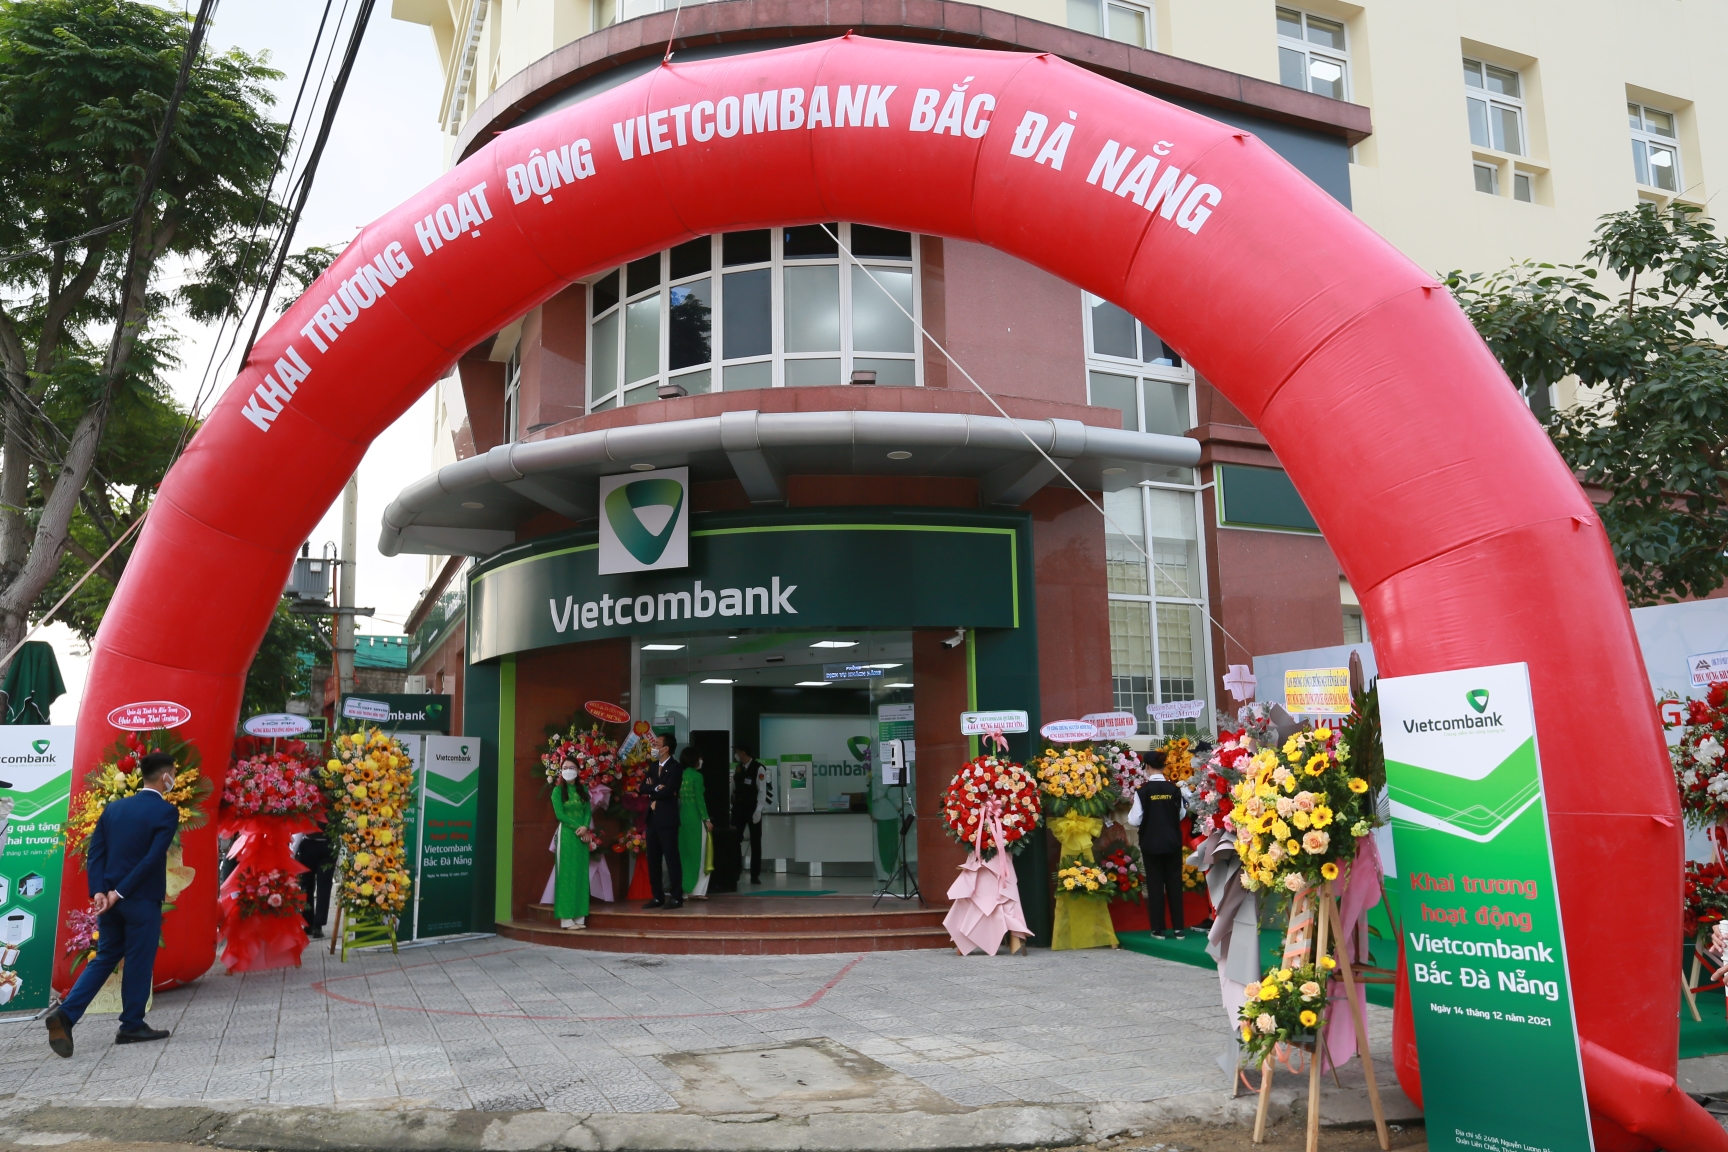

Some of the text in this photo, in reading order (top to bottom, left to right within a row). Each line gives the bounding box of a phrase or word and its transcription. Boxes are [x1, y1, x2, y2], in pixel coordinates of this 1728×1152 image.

[241, 75, 1222, 432] KHAI TRƯƠNG HOẠT ĐỘNG VIETCOMBANK BẮC ĐÀ NẴNG
[550, 576, 799, 633] Vietcombank
[1403, 711, 1504, 733] Vietcombank
[0, 754, 57, 764] combank
[436, 754, 472, 762] Vietcombank
[17, 823, 35, 832] quà
[38, 822, 60, 832] tặng
[5, 836, 59, 845] hai trương
[424, 844, 473, 854] Vietcombank
[423, 855, 472, 867] Bắc Đà Nẵng
[1410, 872, 1538, 900] Khai trương
[1421, 903, 1533, 932] hoạt động
[1410, 932, 1555, 963] Vietcombank
[1414, 960, 1559, 1001] Bắc Đà Nẵng
[1430, 1003, 1551, 1026] Ngày 14 tháng 12 năm 2021
